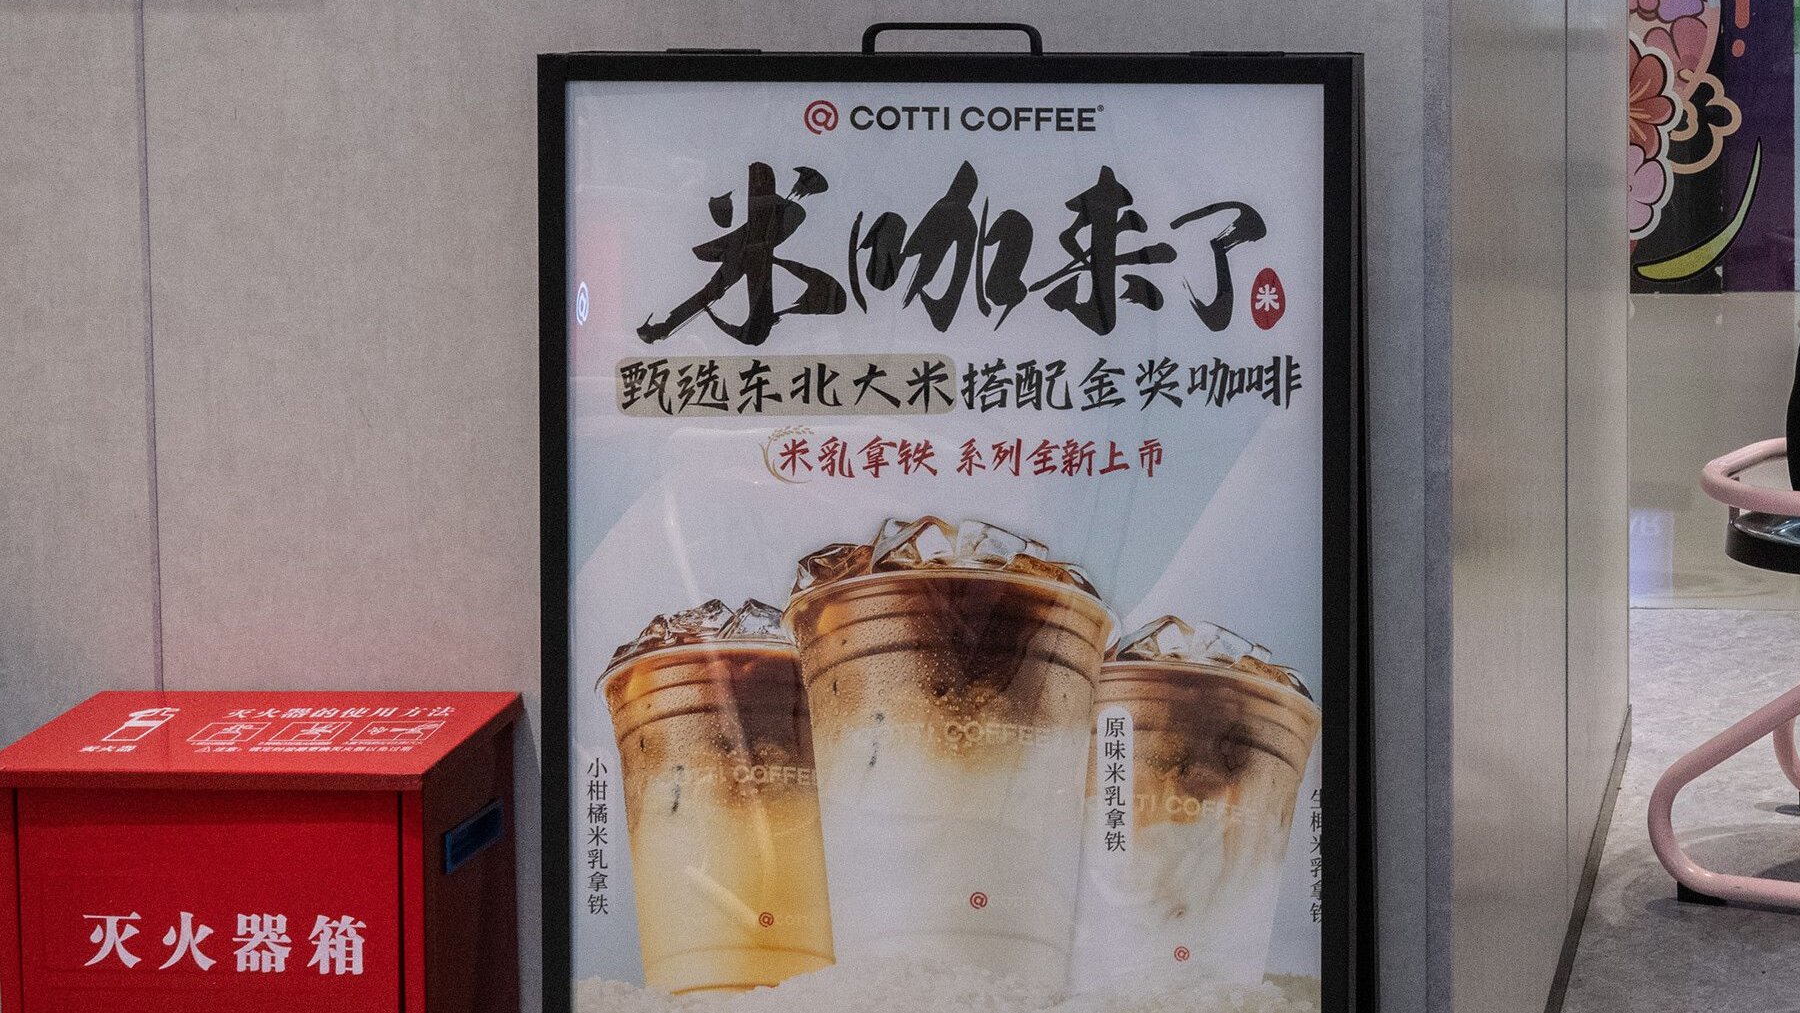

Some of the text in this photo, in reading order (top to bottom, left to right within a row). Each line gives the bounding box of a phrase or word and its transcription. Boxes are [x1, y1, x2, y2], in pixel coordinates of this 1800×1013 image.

[850, 105, 950, 133] COTTI
[637, 160, 1267, 345] 米咖来了
[1255, 282, 1281, 315] 米
[225, 706, 457, 720] 灭火器的使用方法
[1104, 716, 1127, 853] 原味米乳拿铁
[586, 756, 609, 916] 小柑橘米乳拿铁
[82, 911, 367, 976] 灭火器箱
